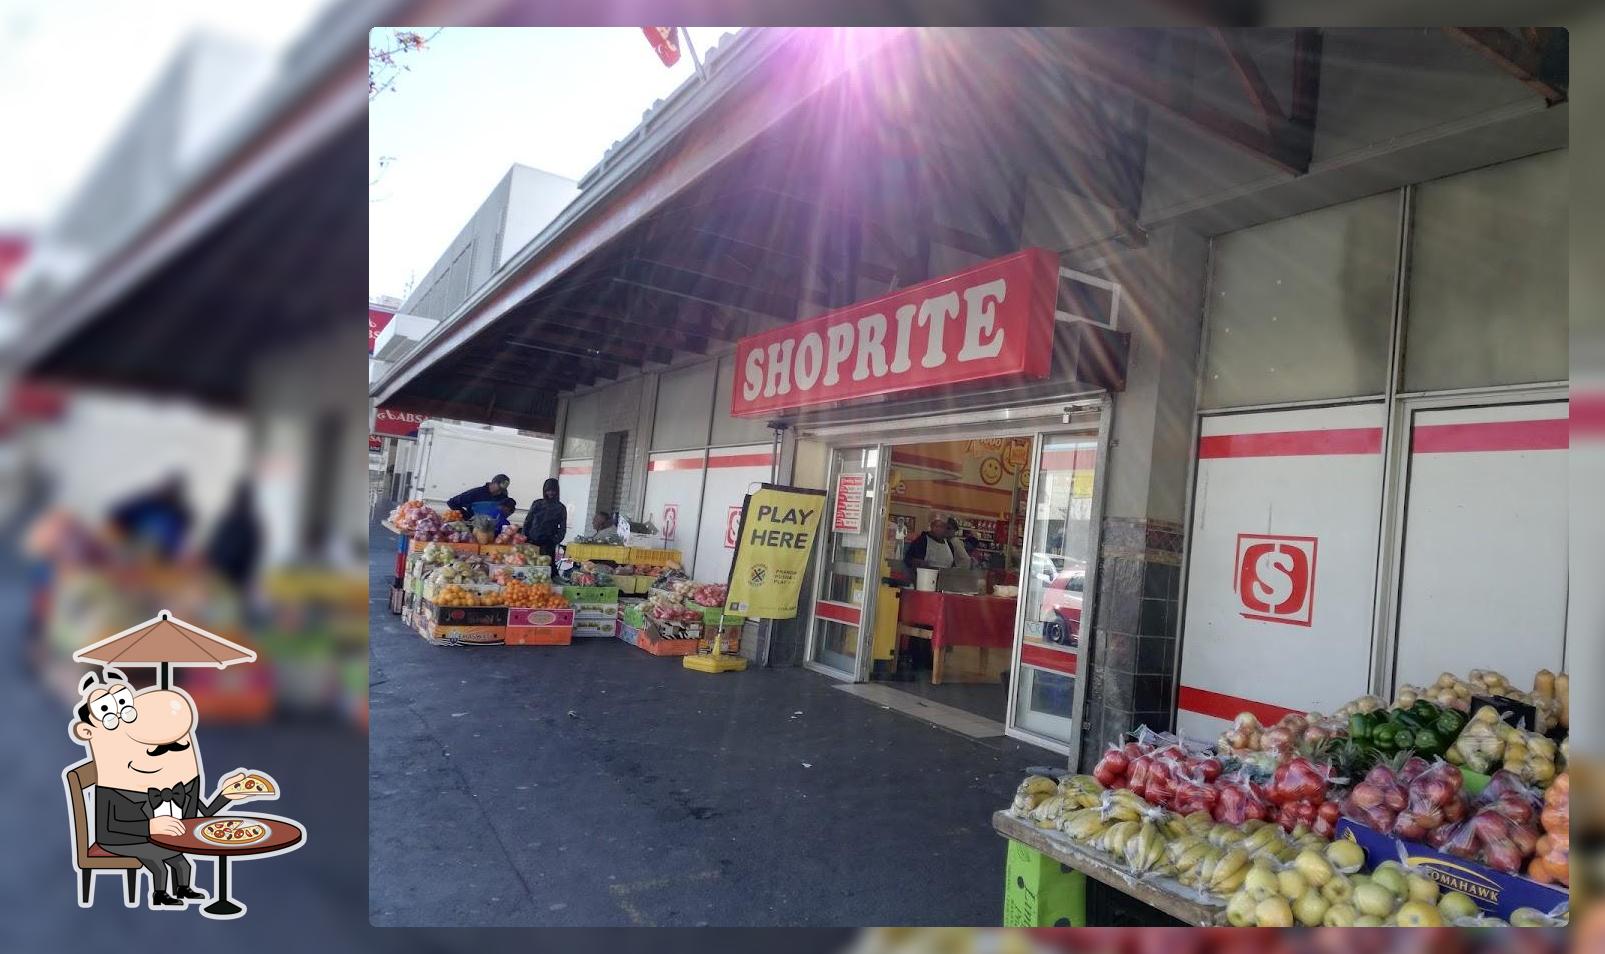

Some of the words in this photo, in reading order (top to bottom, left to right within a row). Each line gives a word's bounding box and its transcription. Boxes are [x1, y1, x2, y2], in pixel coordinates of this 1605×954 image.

[743, 278, 1007, 401] SHOPRITE
[757, 505, 814, 526] PLAY
[750, 529, 808, 549] HERE
[1431, 871, 1499, 902] OMAHAWK
